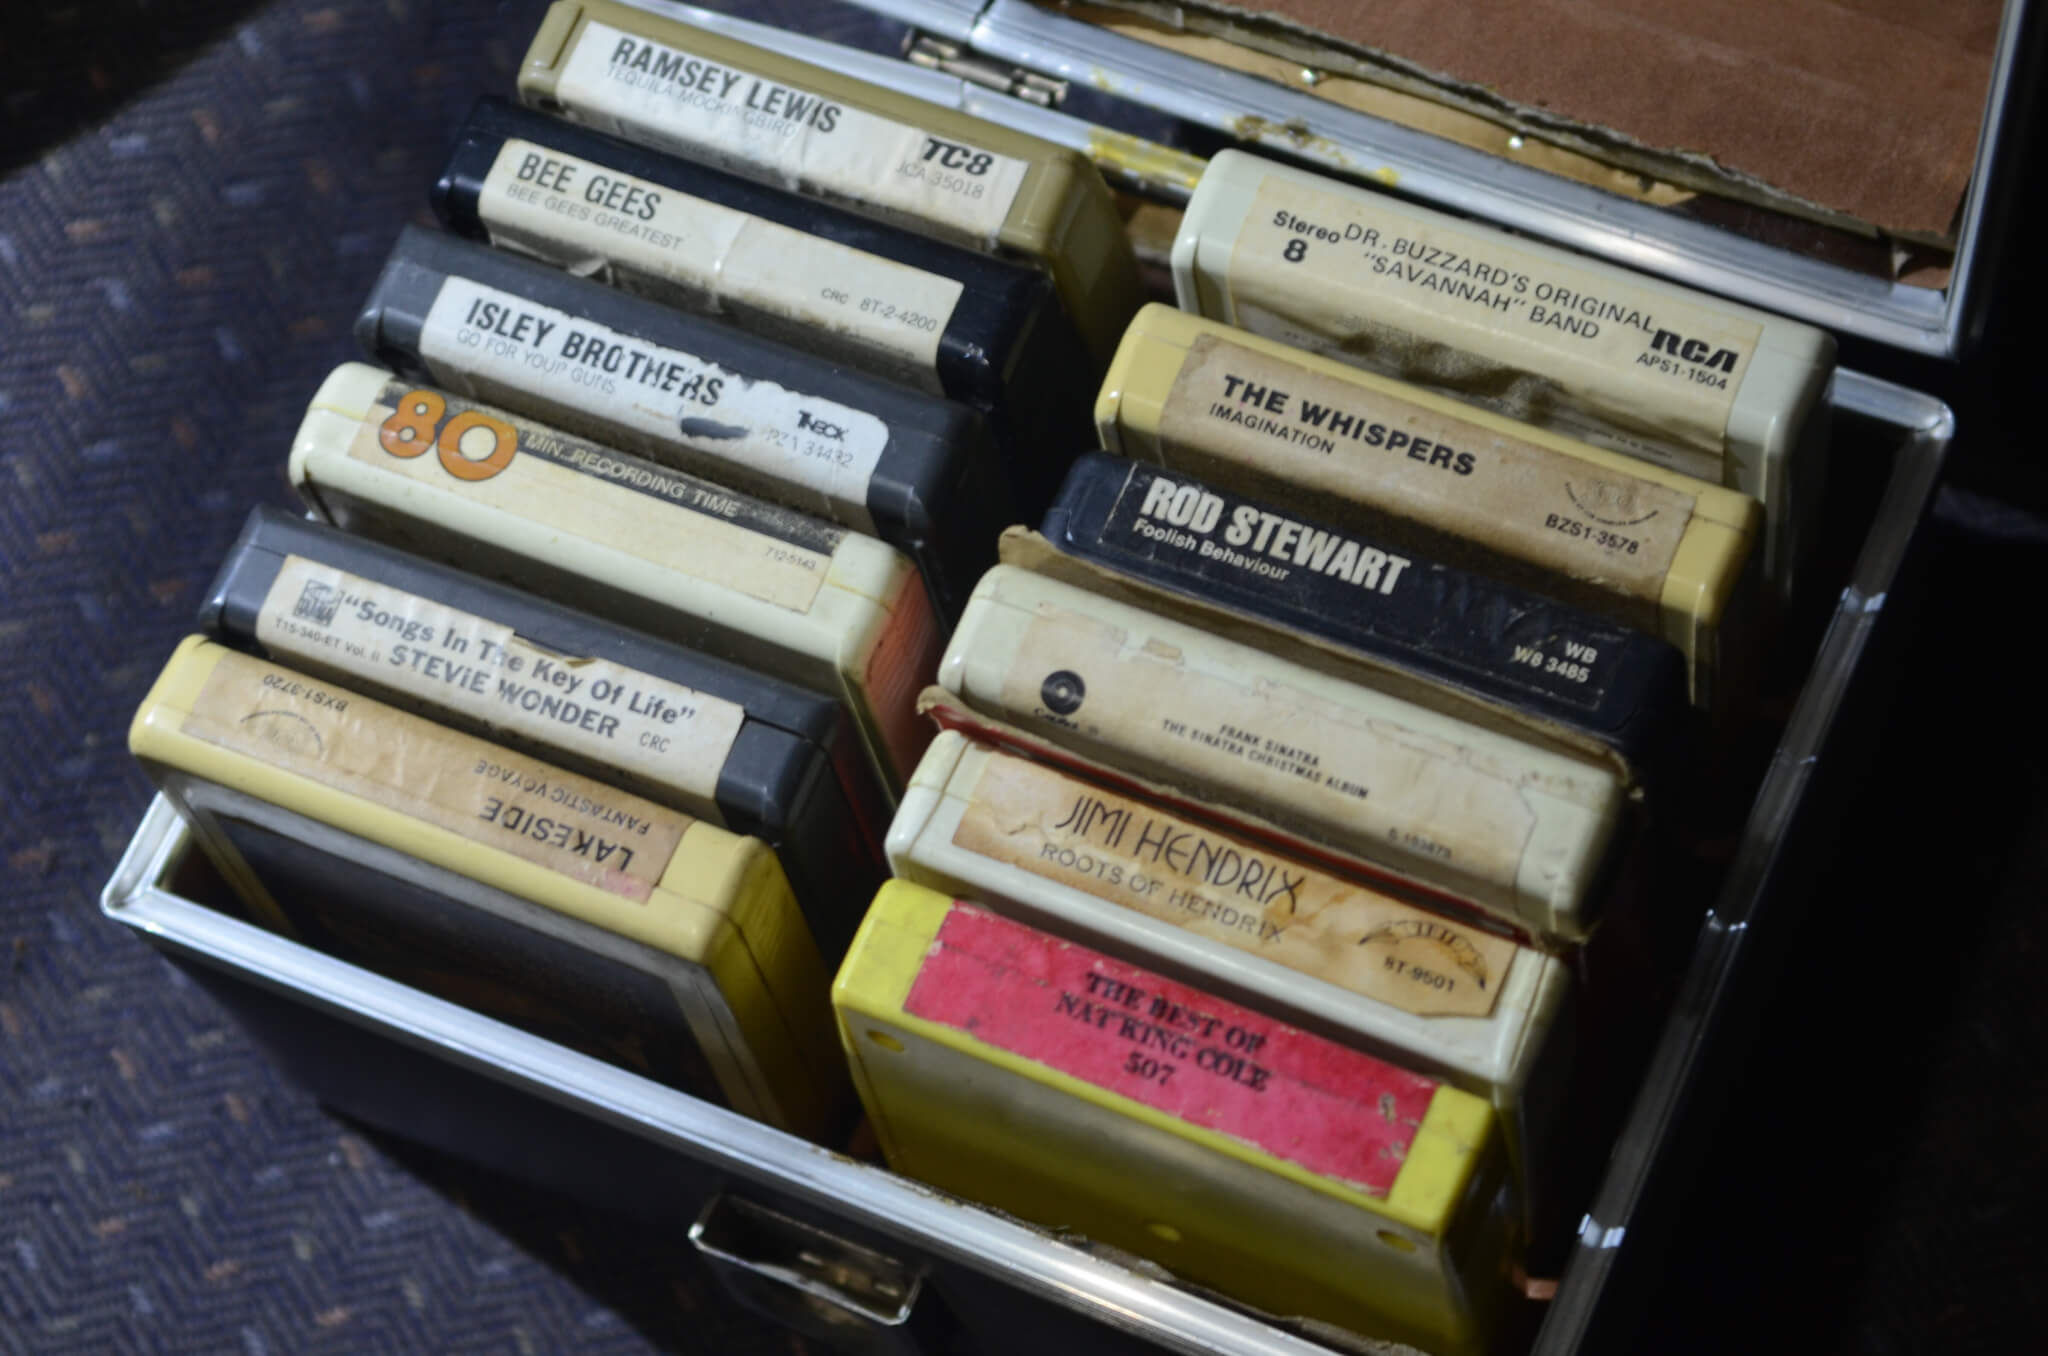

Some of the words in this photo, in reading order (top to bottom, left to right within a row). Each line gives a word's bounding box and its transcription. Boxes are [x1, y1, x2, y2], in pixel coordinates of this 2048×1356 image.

[607, 65, 672, 98] TEQUILA
[675, 92, 798, 138] MOCKINGBIRD
[611, 38, 741, 99] RAMSEY
[746, 80, 842, 133] LEWIS
[516, 153, 577, 193] BEE
[584, 174, 662, 222] GEES
[896, 161, 926, 180] JCA
[929, 170, 985, 199] 35018
[922, 138, 994, 177] TC8
[506, 183, 540, 205] BEE
[544, 193, 591, 219] GEES
[593, 209, 684, 252] GREATEST
[1273, 210, 1342, 246] Stereo
[1283, 239, 1309, 264] 8
[1344, 222, 1388, 250] DR.
[1391, 238, 1531, 294] BUZZARD'S
[1535, 283, 1656, 336] ORIGINAL
[820, 287, 849, 306] CRC
[859, 297, 939, 334] 8T-2-4200
[1529, 305, 1601, 341] BAND
[457, 328, 482, 348] GO
[485, 338, 518, 359] FOR
[571, 366, 617, 395] GUNS
[466, 299, 556, 348] ISLEY
[561, 330, 725, 406] BROTHERS
[1636, 350, 1729, 392] APS1-1504
[1649, 328, 1740, 375] RCA
[379, 389, 519, 482] 80
[1208, 402, 1337, 457] IMAGINATION
[1223, 374, 1292, 416] THE
[1299, 402, 1478, 478] WHISPERS
[569, 446, 684, 500] RECORDING
[693, 488, 739, 518] TIME
[1131, 518, 1198, 552] Foolish
[1198, 534, 1291, 583] Behaviour
[1138, 475, 1226, 536] ROD
[1224, 504, 1413, 596] STEWART
[1545, 513, 1640, 555] BZS1-3578
[443, 627, 468, 654] In
[532, 658, 584, 695] Key
[591, 678, 624, 706] Of
[1565, 640, 1598, 664] WB
[499, 679, 621, 740] WONDER
[639, 731, 672, 755] CRC
[1162, 718, 1187, 737] THE
[1191, 728, 1244, 758] SINATRA
[1248, 750, 1323, 783] CHRISTMAS
[1325, 776, 1370, 800] ALBUM
[1219, 724, 1260, 747] FRANK
[1265, 738, 1320, 768] SINATRA
[473, 758, 548, 801] VOYAGE
[552, 785, 652, 836] FANTASTIC
[478, 797, 635, 875] LAKESIDE
[1053, 795, 1125, 849] JIMI
[1137, 819, 1306, 915] HENDRIX
[1040, 841, 1124, 888] ROOTS
[1129, 870, 1165, 897] OF
[1169, 887, 1288, 944] HENDRIX
[1086, 969, 1147, 1011] THE
[1148, 993, 1223, 1038] BEST
[1054, 990, 1119, 1030] NAT
[1118, 1011, 1197, 1061] KING
[1195, 1047, 1273, 1093] COLE
[1124, 1050, 1177, 1087] 507
